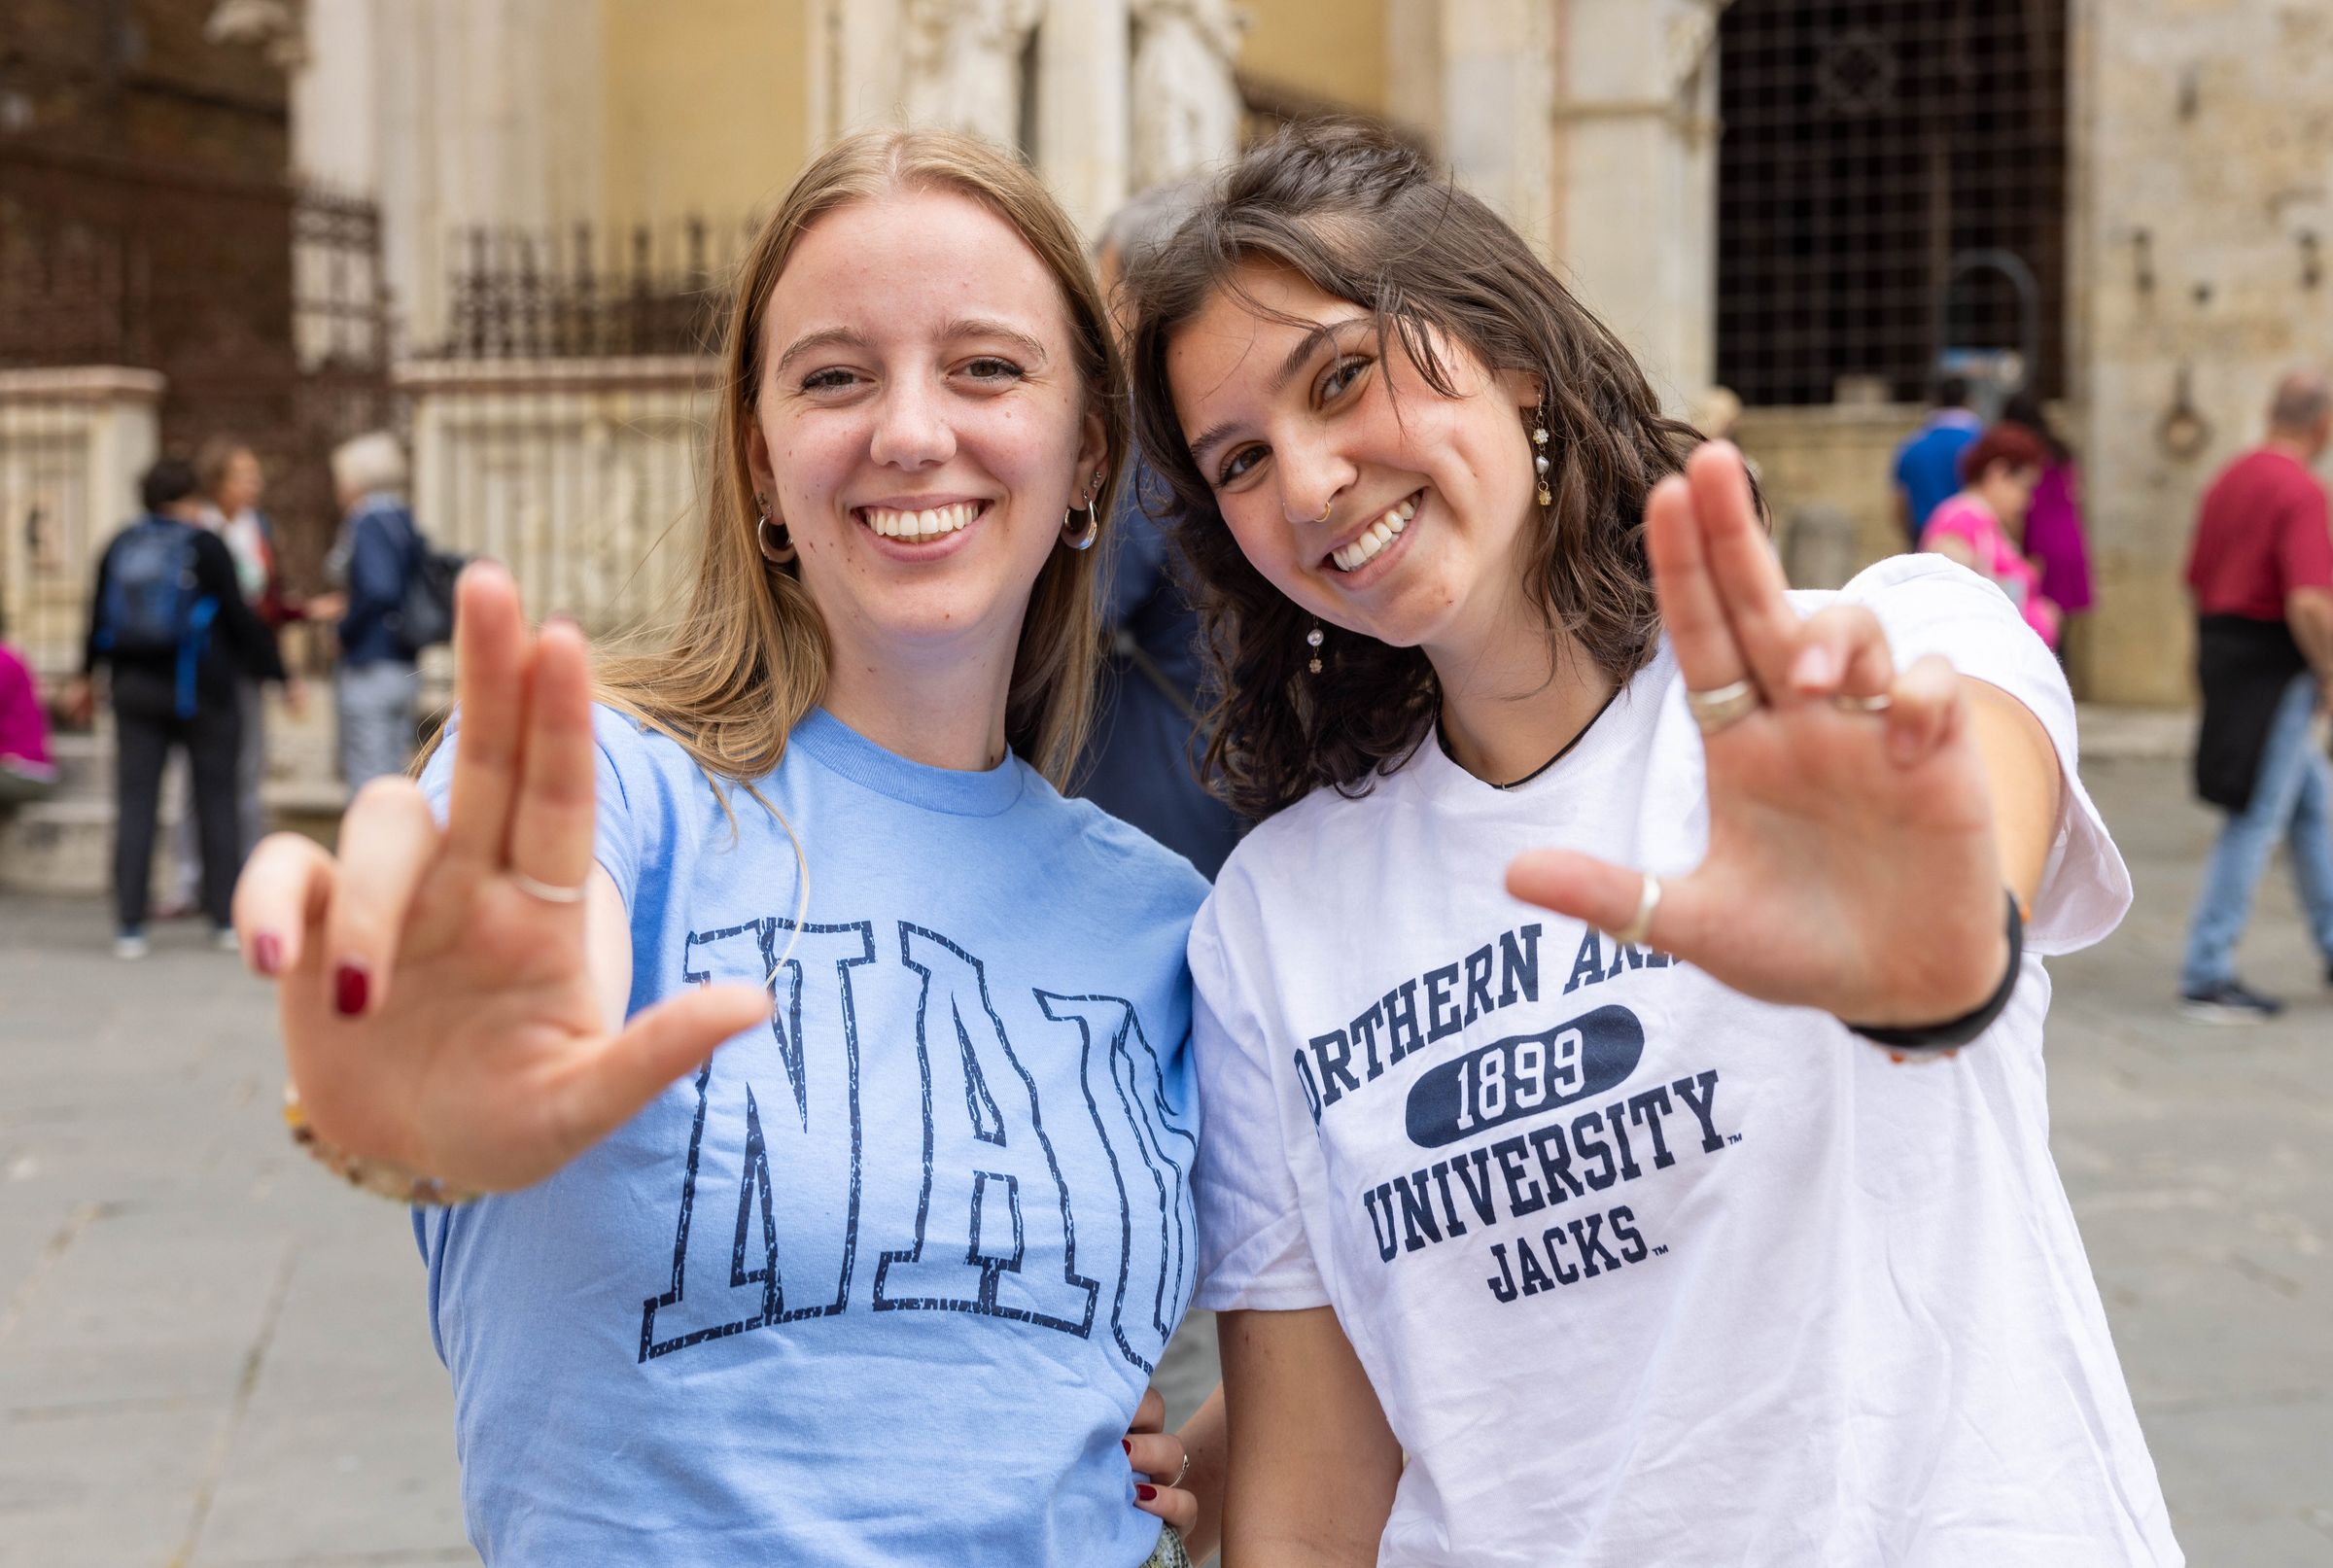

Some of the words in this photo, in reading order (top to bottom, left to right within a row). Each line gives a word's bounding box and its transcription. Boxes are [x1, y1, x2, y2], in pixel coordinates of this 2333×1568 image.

[1294, 923, 1542, 1135] ORTHERN
[1456, 1028, 1584, 1131] 1899
[1364, 1069, 1724, 1264] UNIVERSITY
[1487, 1205, 1648, 1304] JACKS
